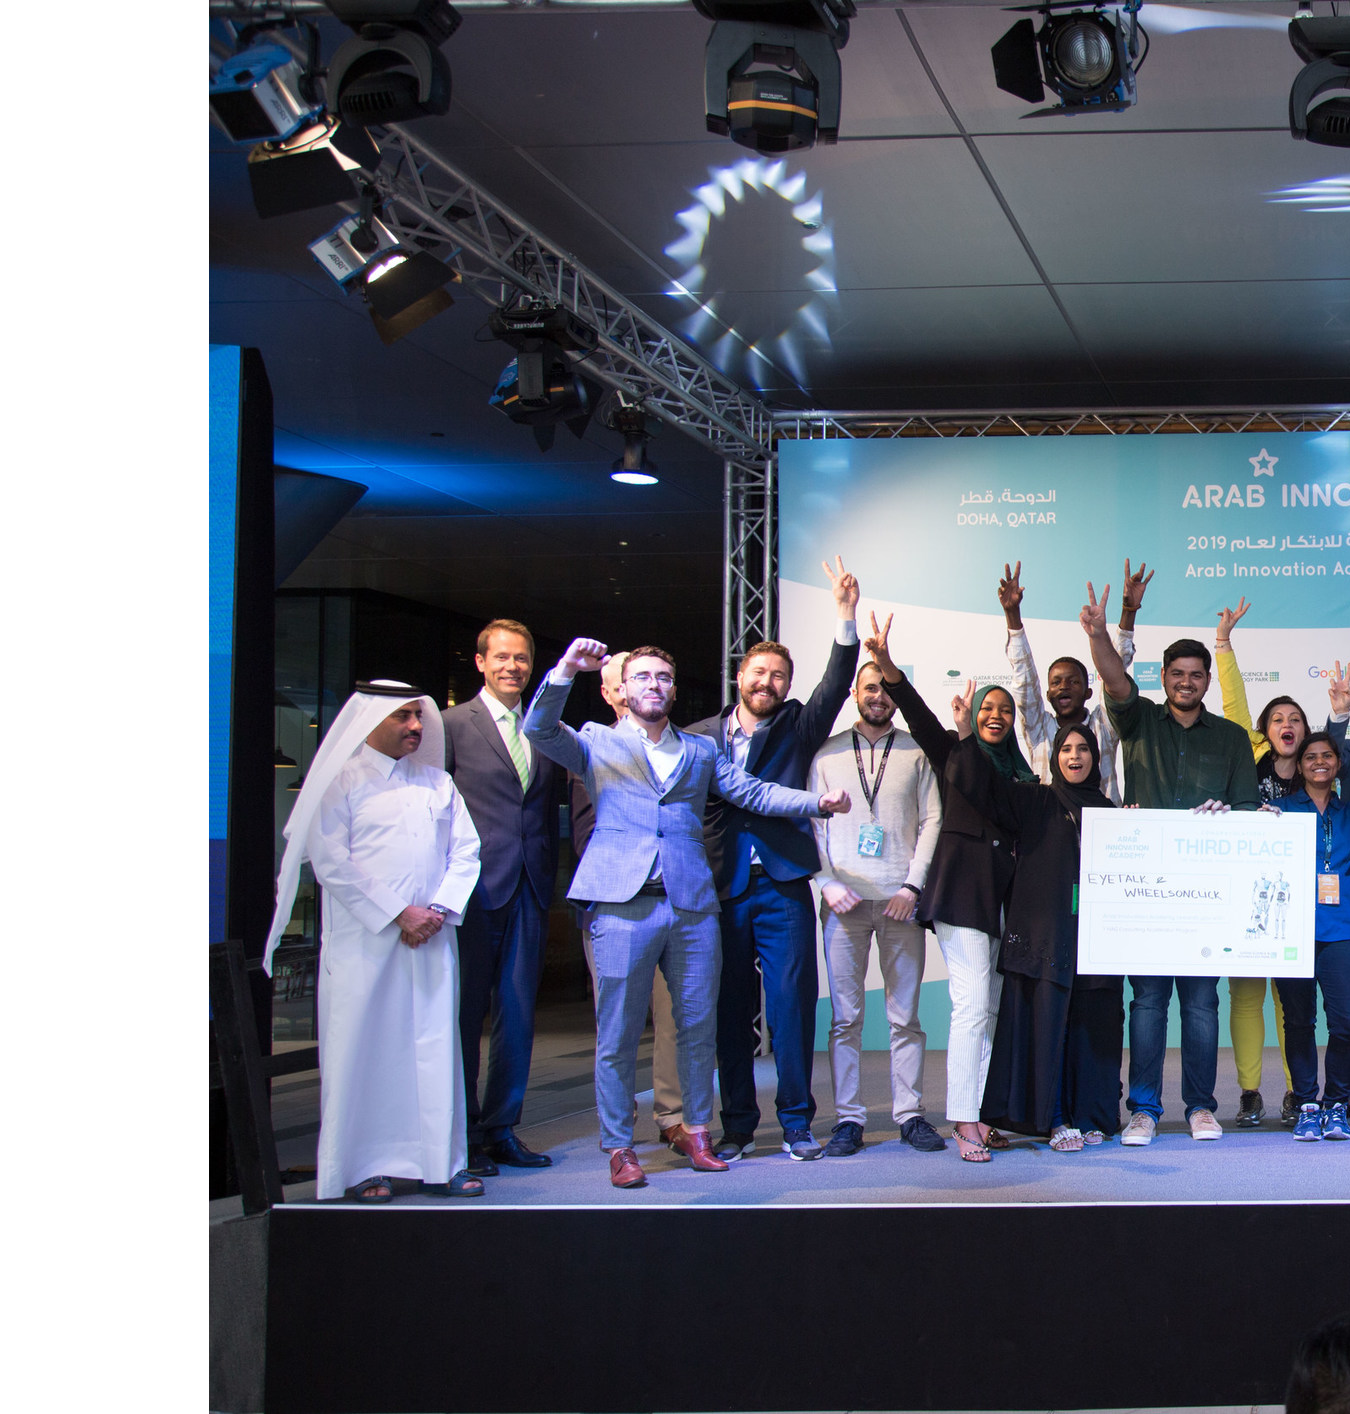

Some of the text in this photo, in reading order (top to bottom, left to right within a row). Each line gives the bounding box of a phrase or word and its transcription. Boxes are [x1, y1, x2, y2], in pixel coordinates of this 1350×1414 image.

[960, 490, 994, 506] قطر
[1182, 484, 1266, 508] ARAB
[957, 511, 1056, 527] DOHA, QATAR
[1187, 536, 1227, 550] 2019
[1231, 536, 1275, 552] لعام
[1280, 535, 1342, 551] للابتكار
[1185, 563, 1227, 578] Arab
[1234, 562, 1326, 577] Innovation
[1174, 838, 1293, 857] THIRD PLACE
[1088, 873, 1149, 885] EYETALK
[1124, 888, 1223, 900] WHEELSONCLICK
